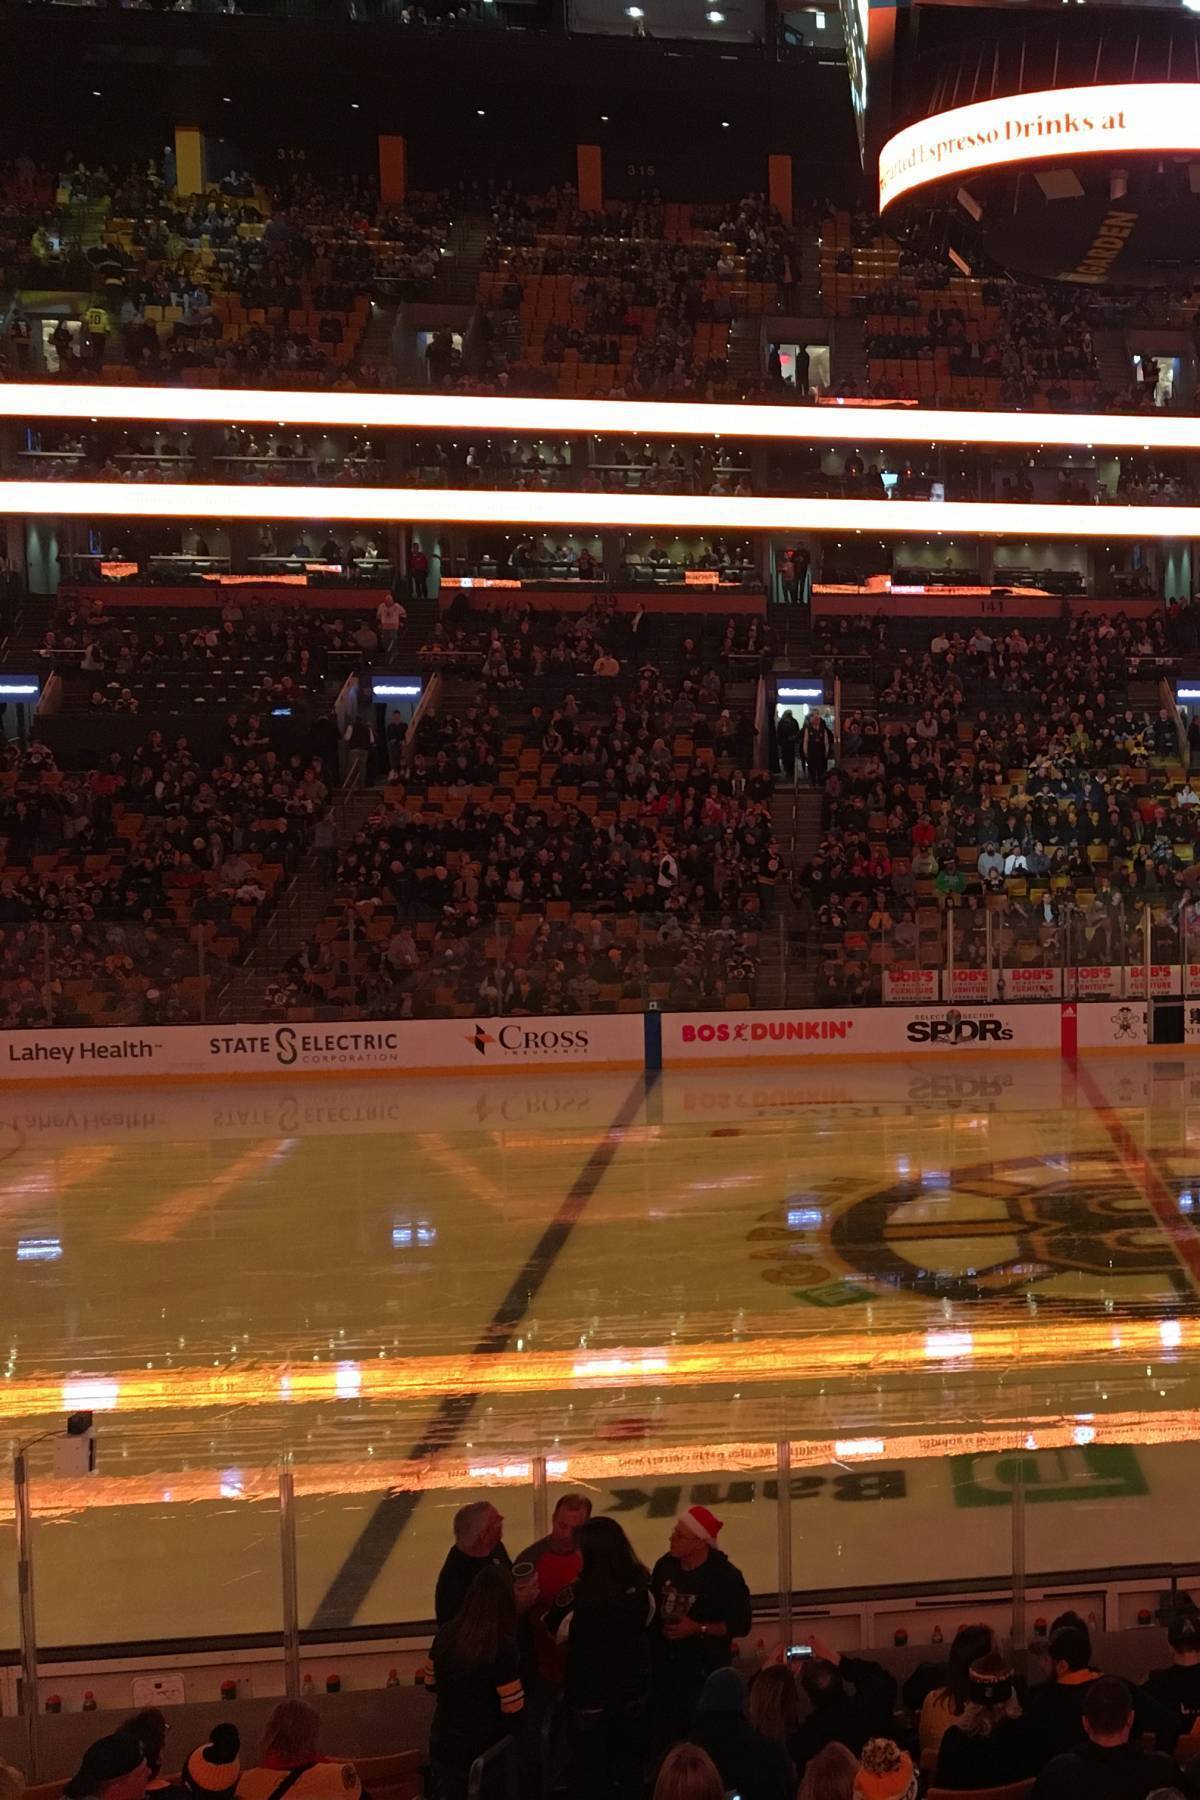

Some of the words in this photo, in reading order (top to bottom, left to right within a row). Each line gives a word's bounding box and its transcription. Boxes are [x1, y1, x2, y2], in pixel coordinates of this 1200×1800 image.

[919, 128, 998, 162] Espresso
[1005, 113, 1094, 141] Drinks
[1105, 110, 1127, 130] at
[277, 148, 305, 160] 314
[627, 164, 655, 176] 315
[1076, 210, 1138, 275] GARDEN
[981, 600, 1003, 613] 141
[1012, 969, 1053, 980] BOB'S
[682, 1024, 730, 1042] BOS
[750, 1020, 854, 1041] DUNKIN'
[10, 1042, 73, 1064] Lahey
[209, 1036, 270, 1055] STATE
[301, 1033, 398, 1052] ELECTRIC
[302, 1053, 398, 1063] CORPORATION
[605, 1469, 907, 1518] Bank
